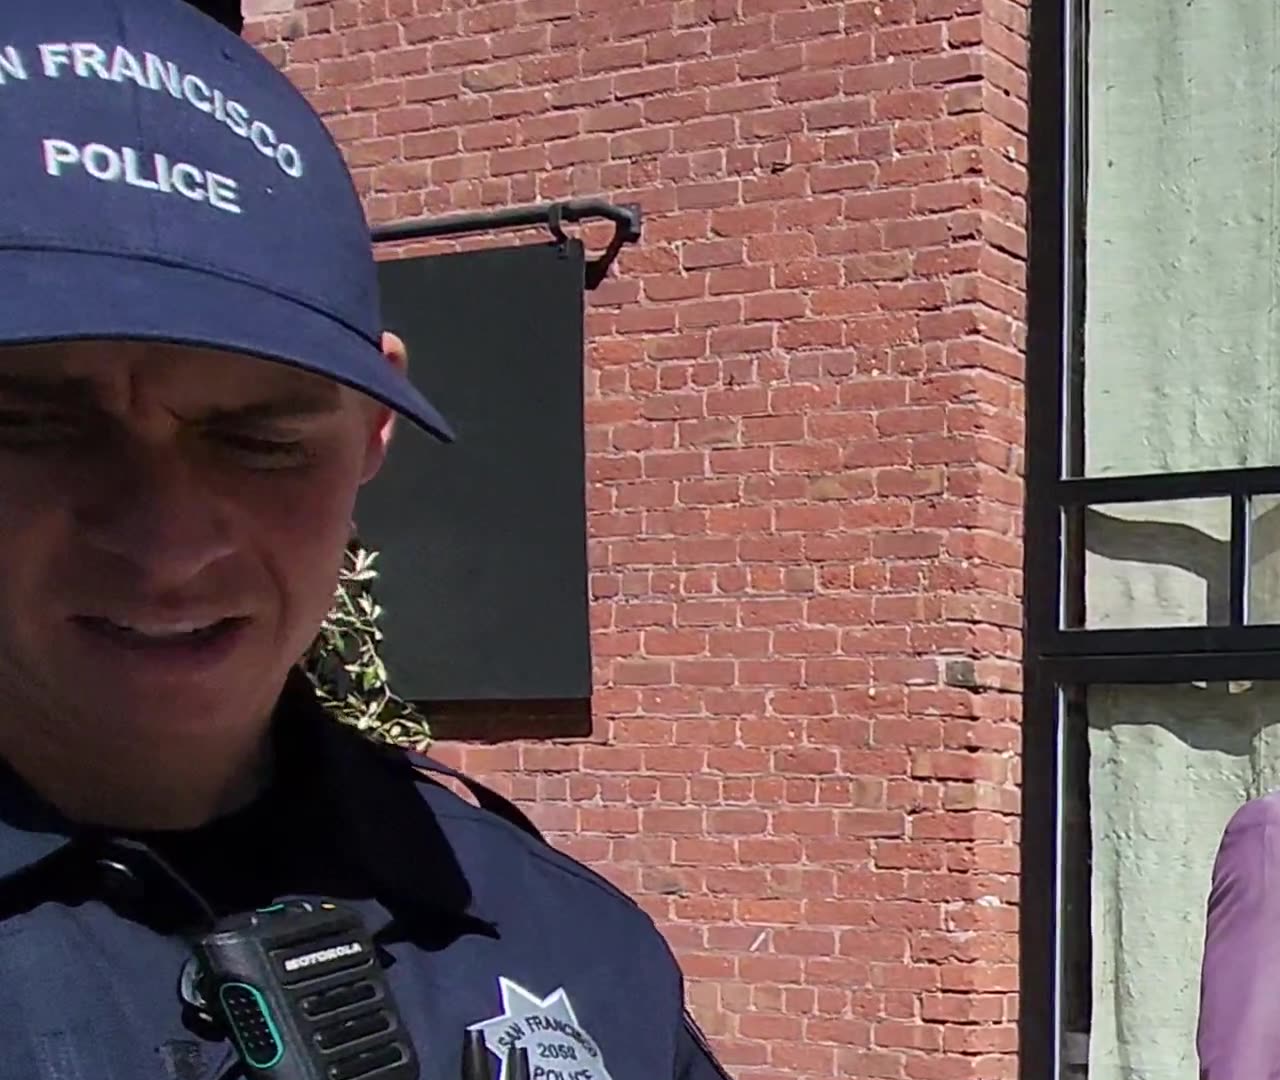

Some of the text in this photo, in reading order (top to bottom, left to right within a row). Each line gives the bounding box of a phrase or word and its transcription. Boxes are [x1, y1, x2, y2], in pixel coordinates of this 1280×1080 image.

[38, 42, 303, 178] FRANCISCO
[42, 138, 243, 214] POLICE
[284, 942, 362, 971] MOTOROLA
